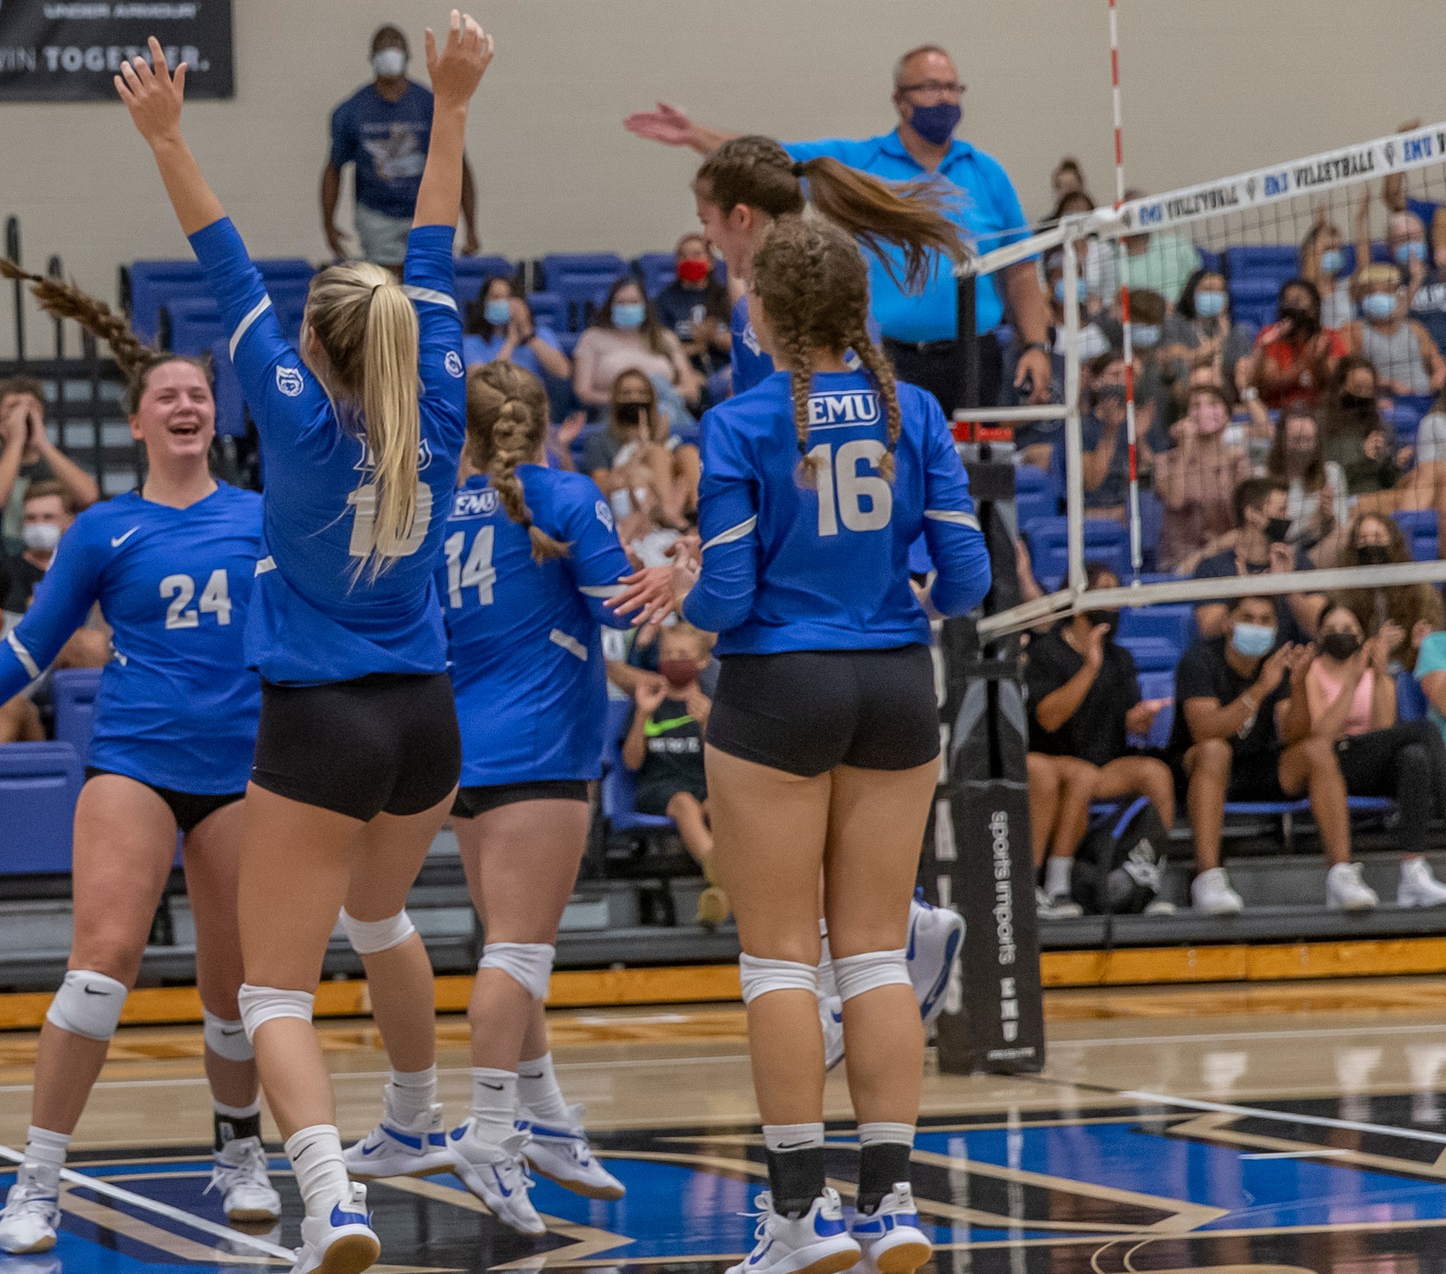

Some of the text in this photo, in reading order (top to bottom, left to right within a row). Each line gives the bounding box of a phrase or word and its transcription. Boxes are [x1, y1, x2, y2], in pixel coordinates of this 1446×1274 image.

[1294, 149, 1374, 188] VOLLEYBALL
[807, 394, 877, 426] EMU
[454, 492, 496, 516] EMU
[808, 439, 894, 538] 16
[159, 568, 232, 630] 24
[444, 525, 497, 608] 14
[988, 811, 1012, 880] sports
[992, 880, 1017, 965] imports
